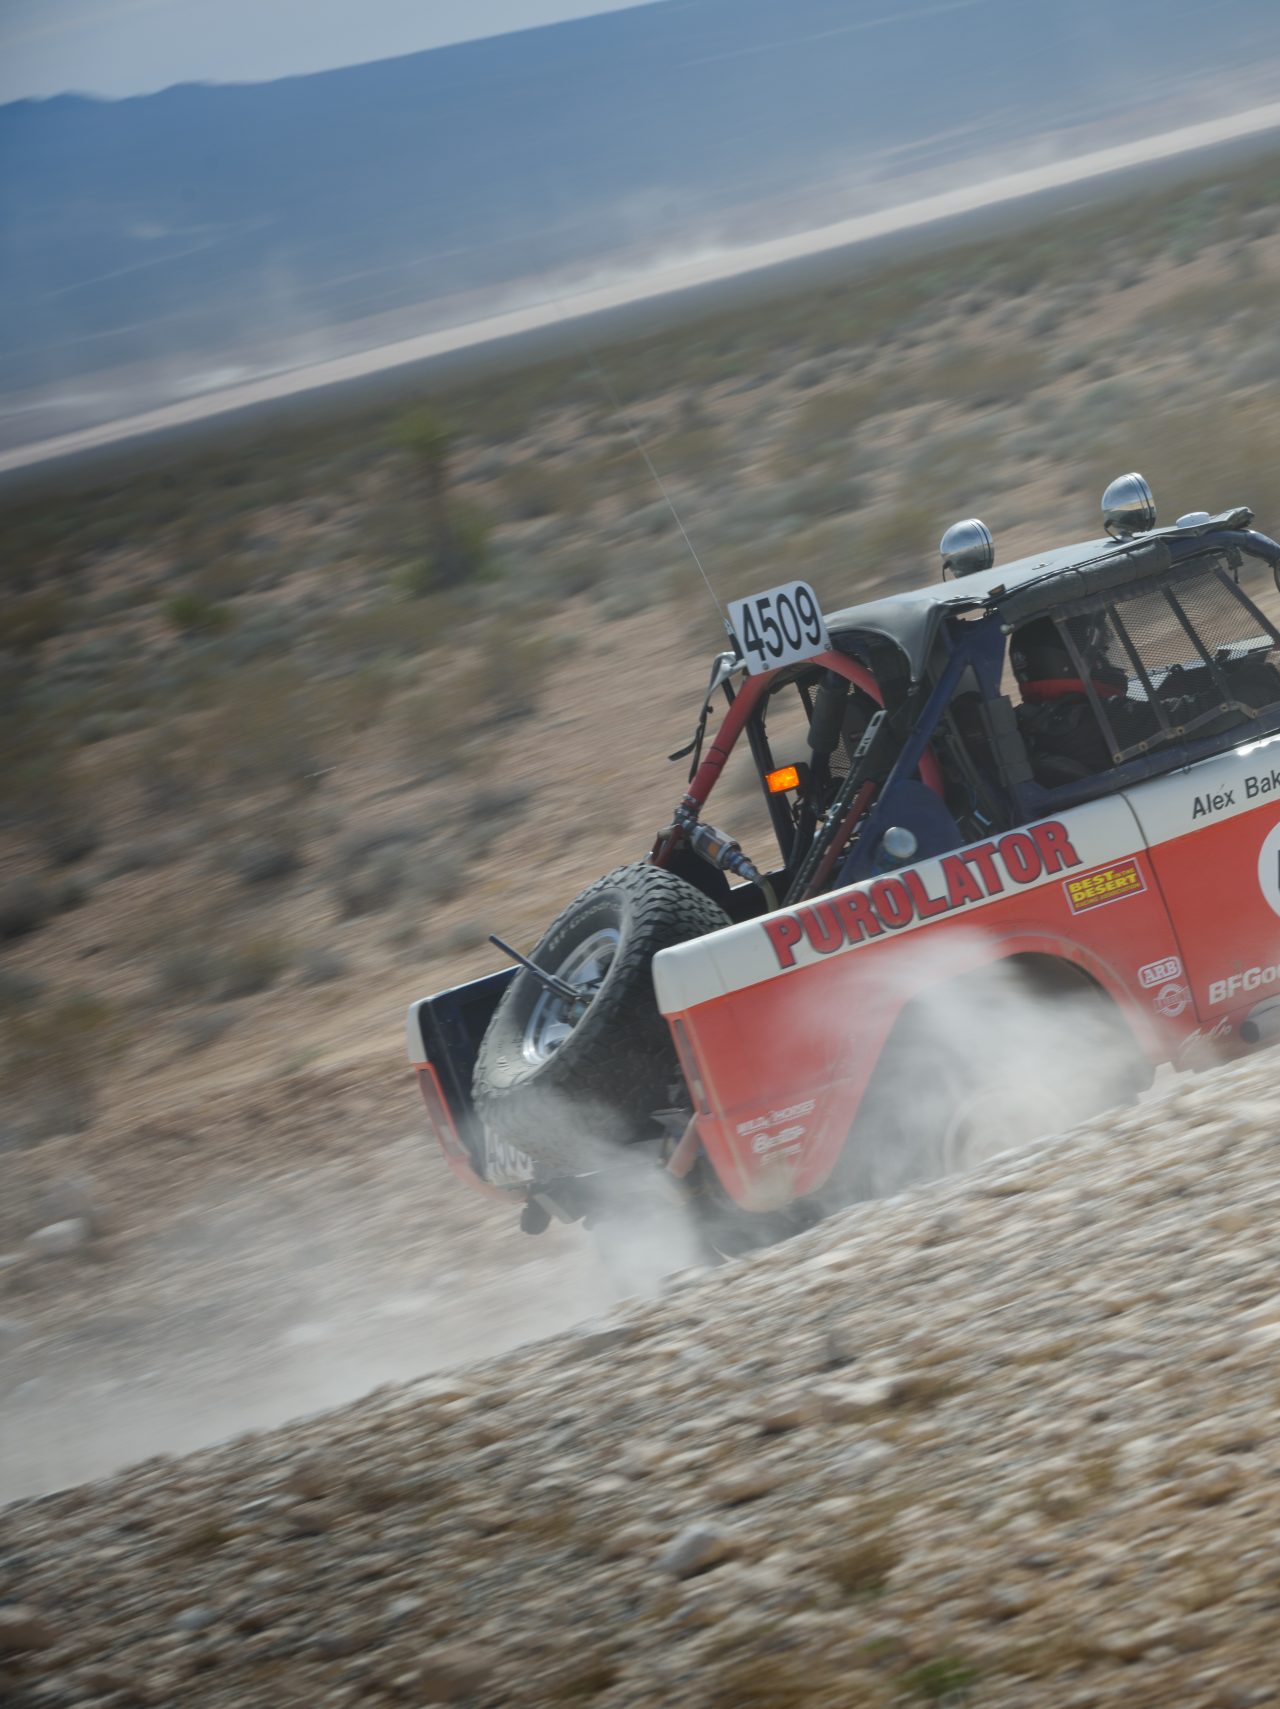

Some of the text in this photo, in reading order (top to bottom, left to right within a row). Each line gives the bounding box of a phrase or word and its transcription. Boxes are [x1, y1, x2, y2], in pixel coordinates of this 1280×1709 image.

[741, 586, 822, 663] 4509
[1192, 787, 1236, 820] Alex
[762, 820, 1083, 969] PUROLATOR
[1068, 870, 1115, 893] BEST
[1071, 873, 1137, 902] DESERT
[1143, 960, 1178, 984] ARB
